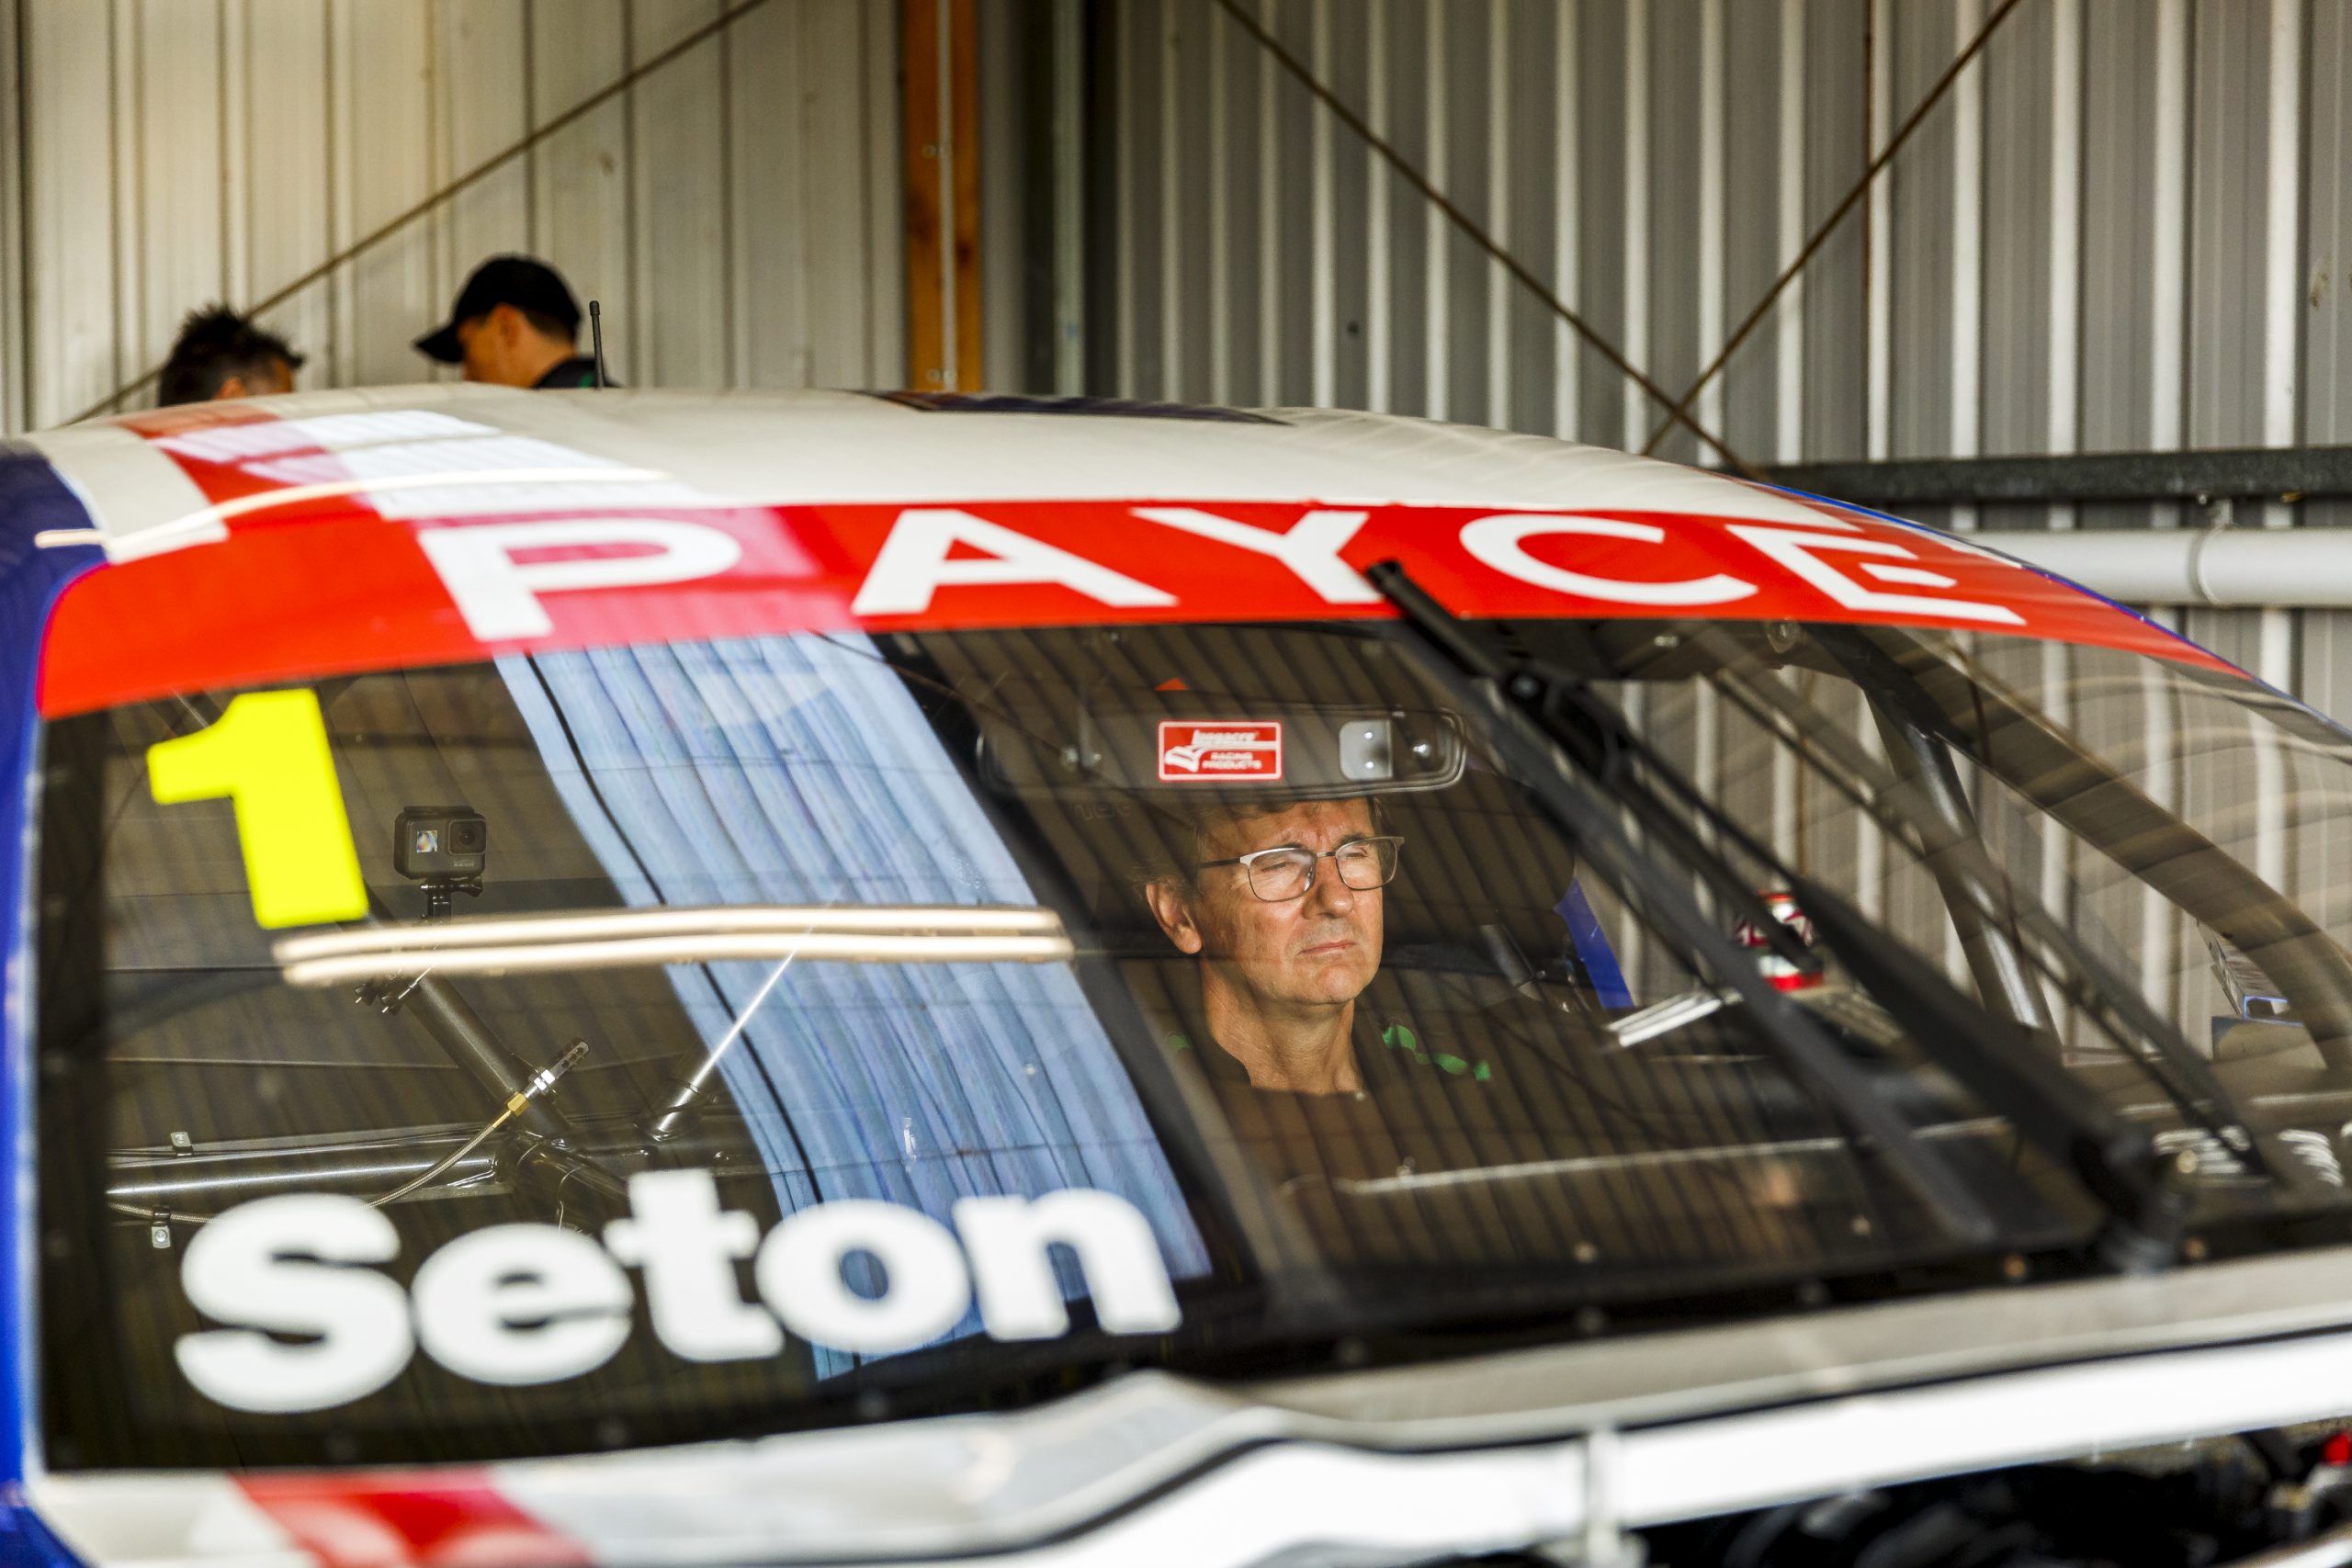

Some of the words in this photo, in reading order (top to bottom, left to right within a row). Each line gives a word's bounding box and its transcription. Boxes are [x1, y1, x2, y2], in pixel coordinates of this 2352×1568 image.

[418, 506, 2026, 641] PAYCE
[146, 690, 368, 930] 1
[175, 1169, 1182, 1415] Seton
